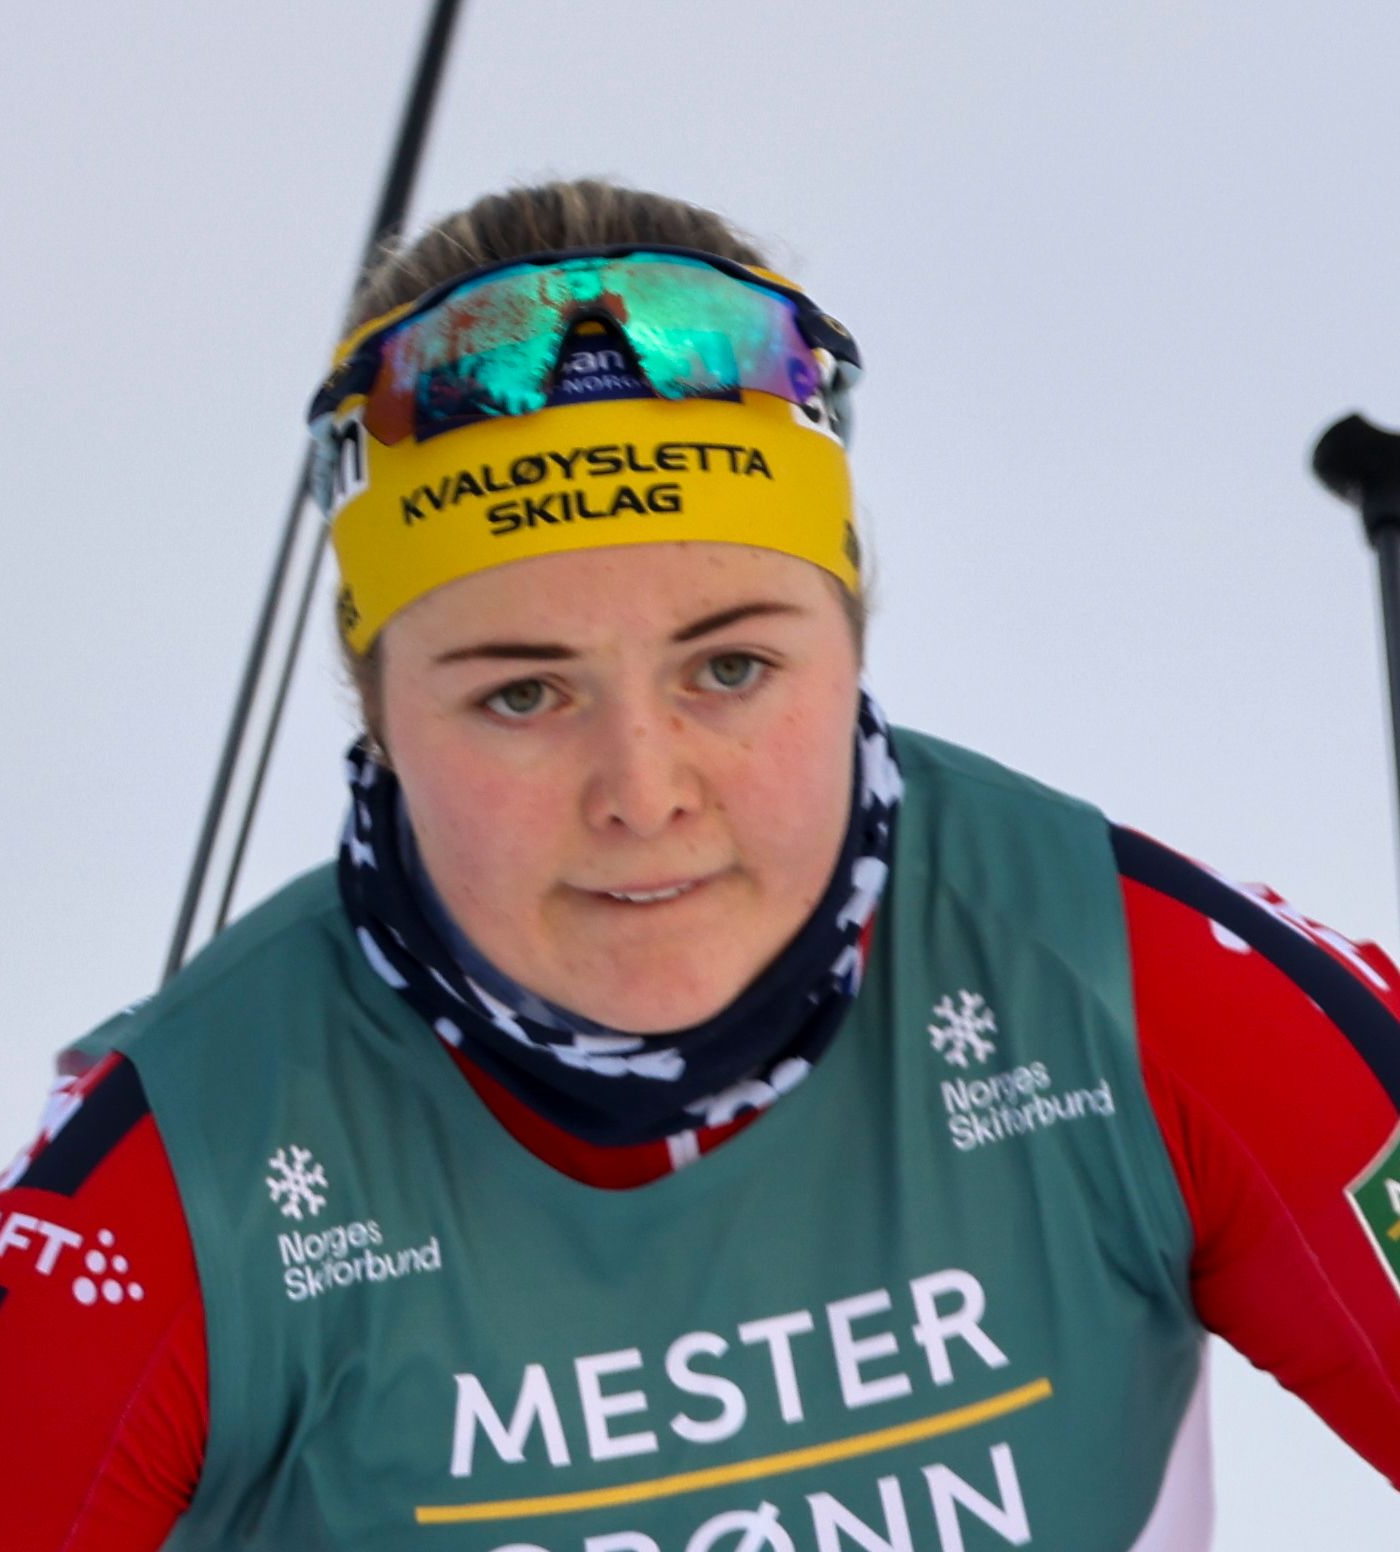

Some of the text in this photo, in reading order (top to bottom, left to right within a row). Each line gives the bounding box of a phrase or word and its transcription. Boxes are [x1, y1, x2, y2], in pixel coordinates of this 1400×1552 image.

[401, 442, 774, 525] KVALØYSLETTA
[487, 483, 683, 536] SKILAG
[939, 1060, 1050, 1113] Norges
[278, 1219, 383, 1267] Norges
[450, 1268, 1009, 1477] MESTER
